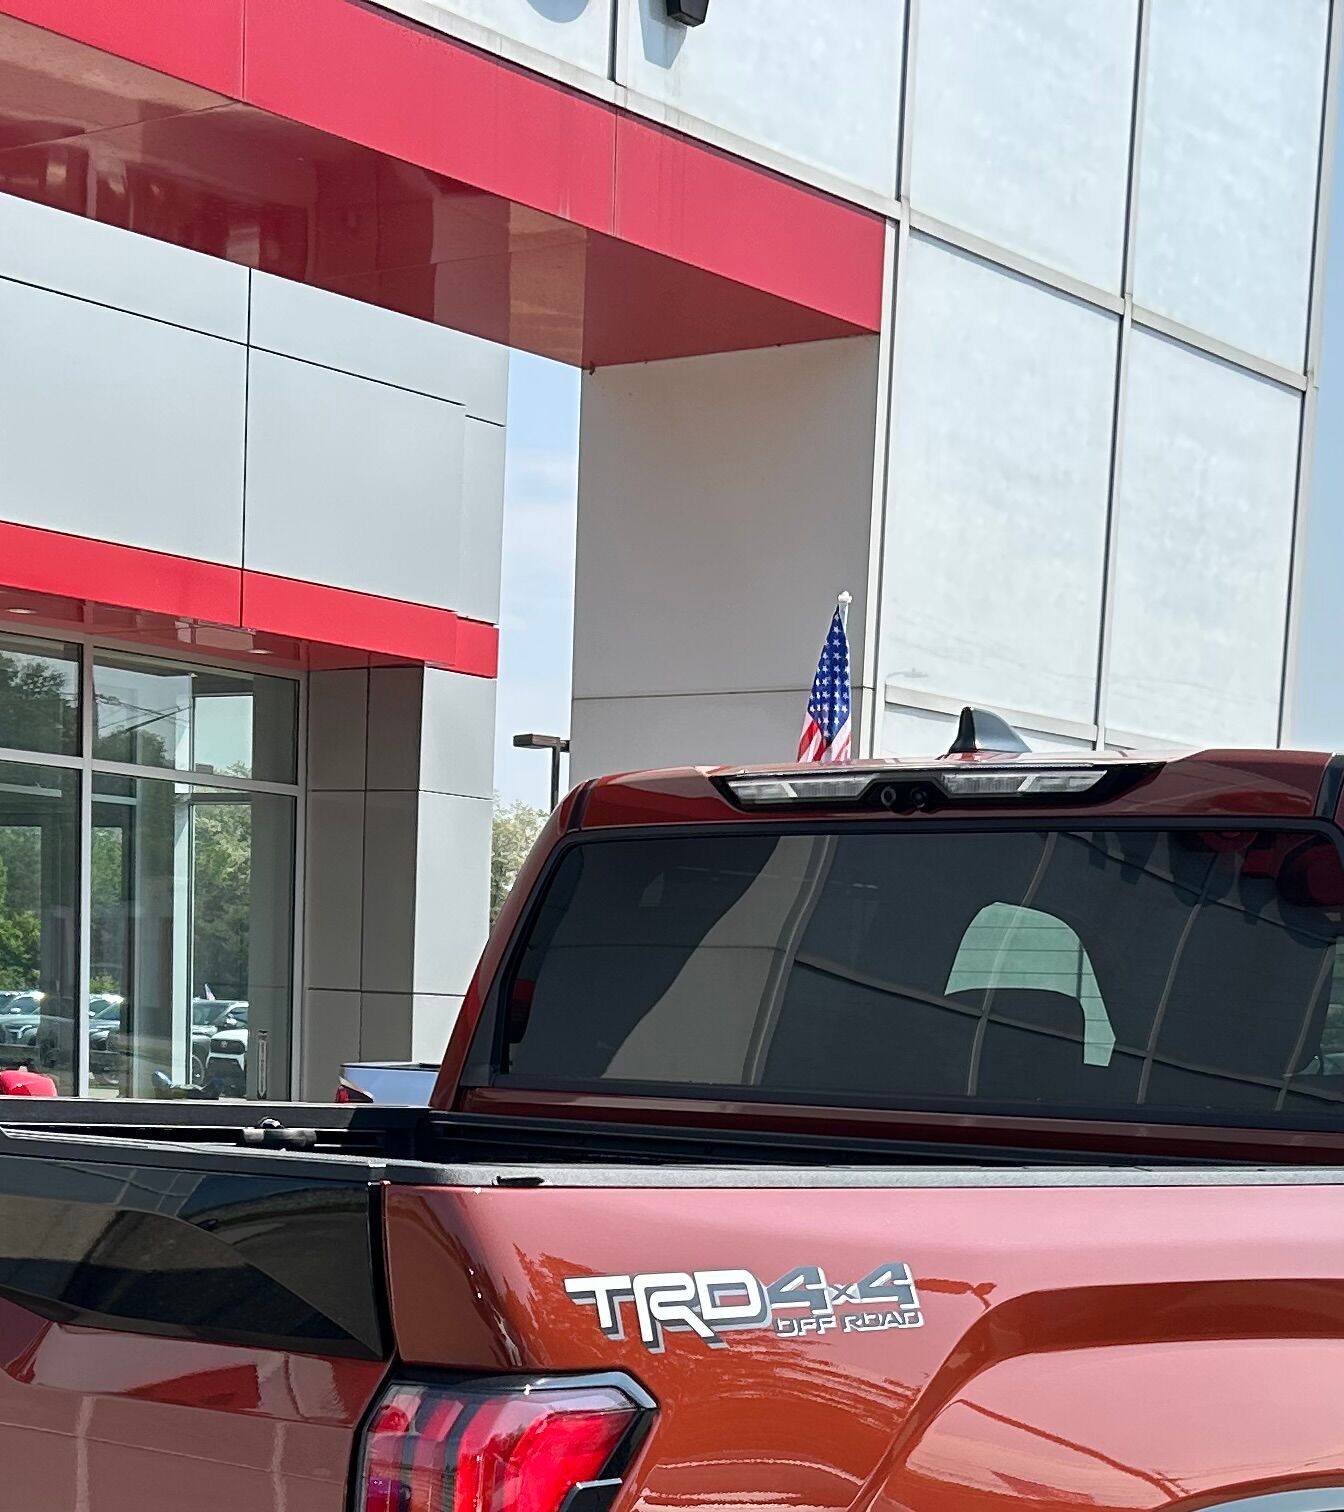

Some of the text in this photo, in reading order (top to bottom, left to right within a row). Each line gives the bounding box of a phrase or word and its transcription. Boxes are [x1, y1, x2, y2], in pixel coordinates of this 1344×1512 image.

[563, 1268, 773, 1354] TRD
[775, 1311, 925, 1338] OFF ROAD
